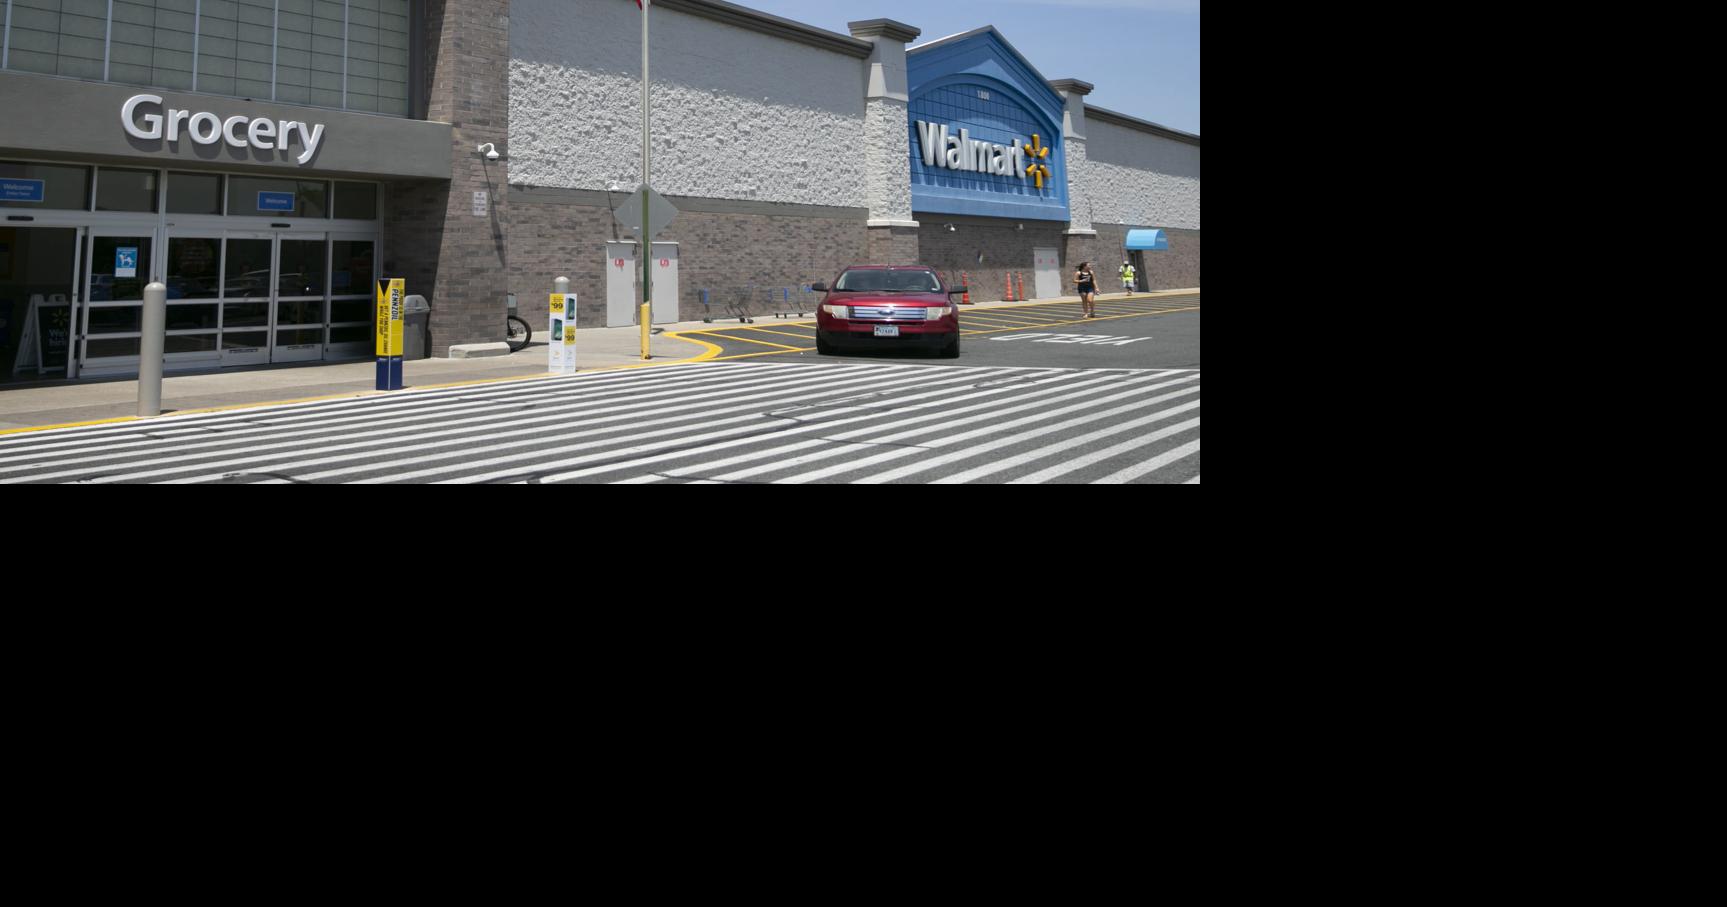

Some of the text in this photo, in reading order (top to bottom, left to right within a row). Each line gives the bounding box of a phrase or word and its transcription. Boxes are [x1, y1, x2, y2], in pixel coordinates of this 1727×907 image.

[121, 94, 325, 164] Grocery
[916, 120, 1026, 178] Walmart
[391, 289, 399, 320] PENNZOIL
[990, 333, 1152, 346] YIELD
